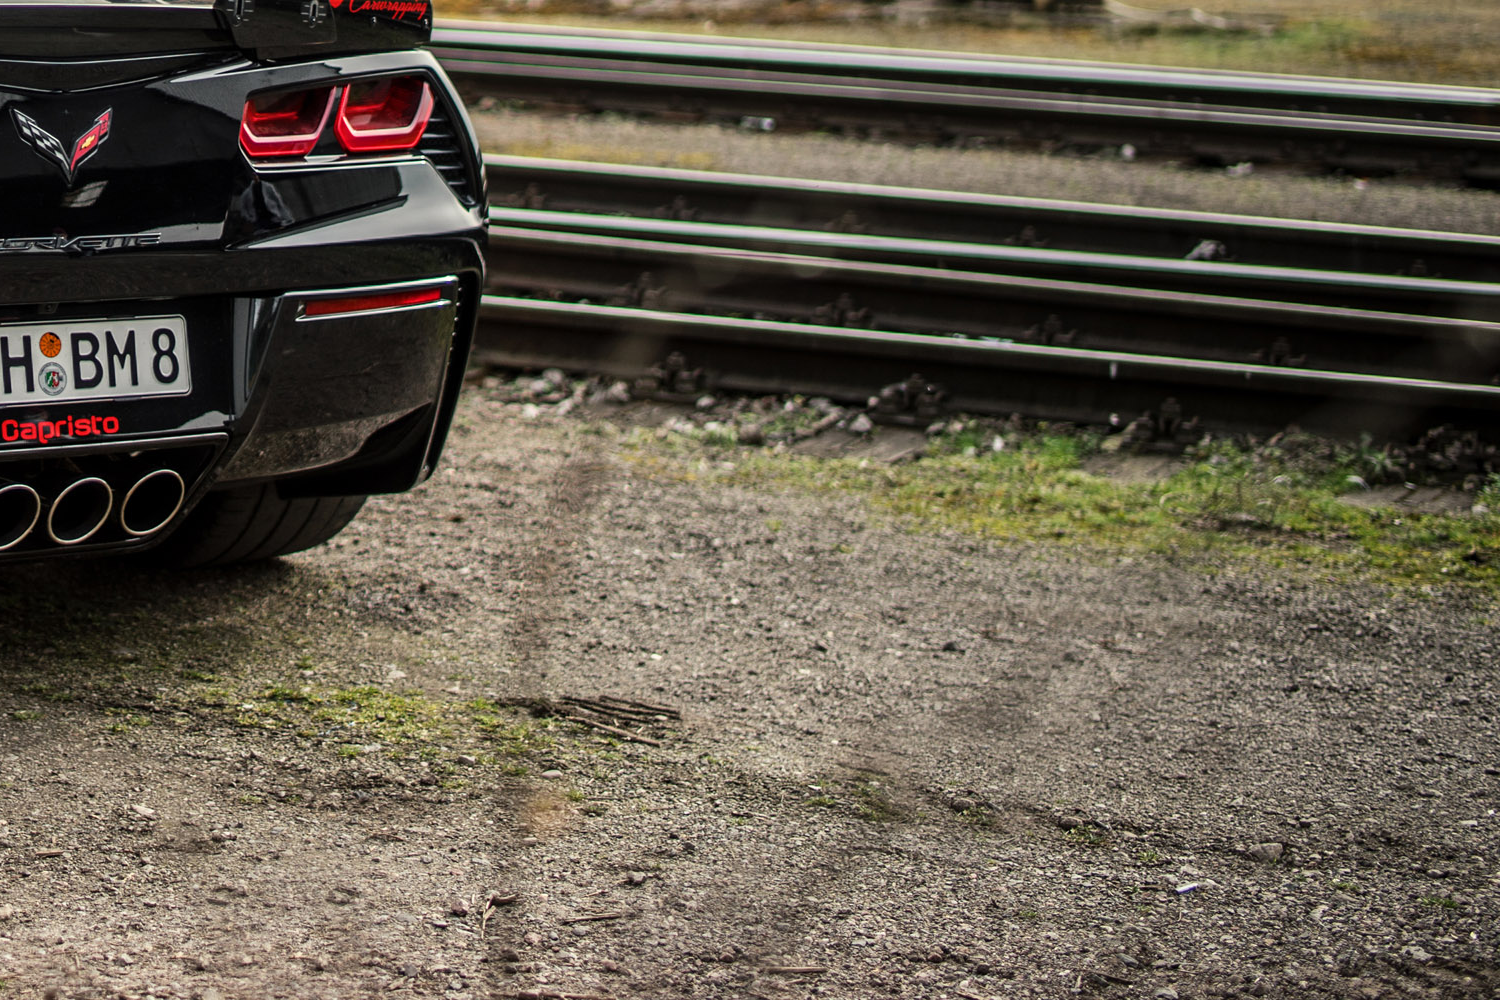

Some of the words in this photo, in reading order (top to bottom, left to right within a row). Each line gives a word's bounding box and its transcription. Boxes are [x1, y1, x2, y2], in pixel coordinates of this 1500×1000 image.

[70, 330, 139, 390] BM
[151, 327, 180, 384] 8
[1, 415, 120, 444] Capristo
